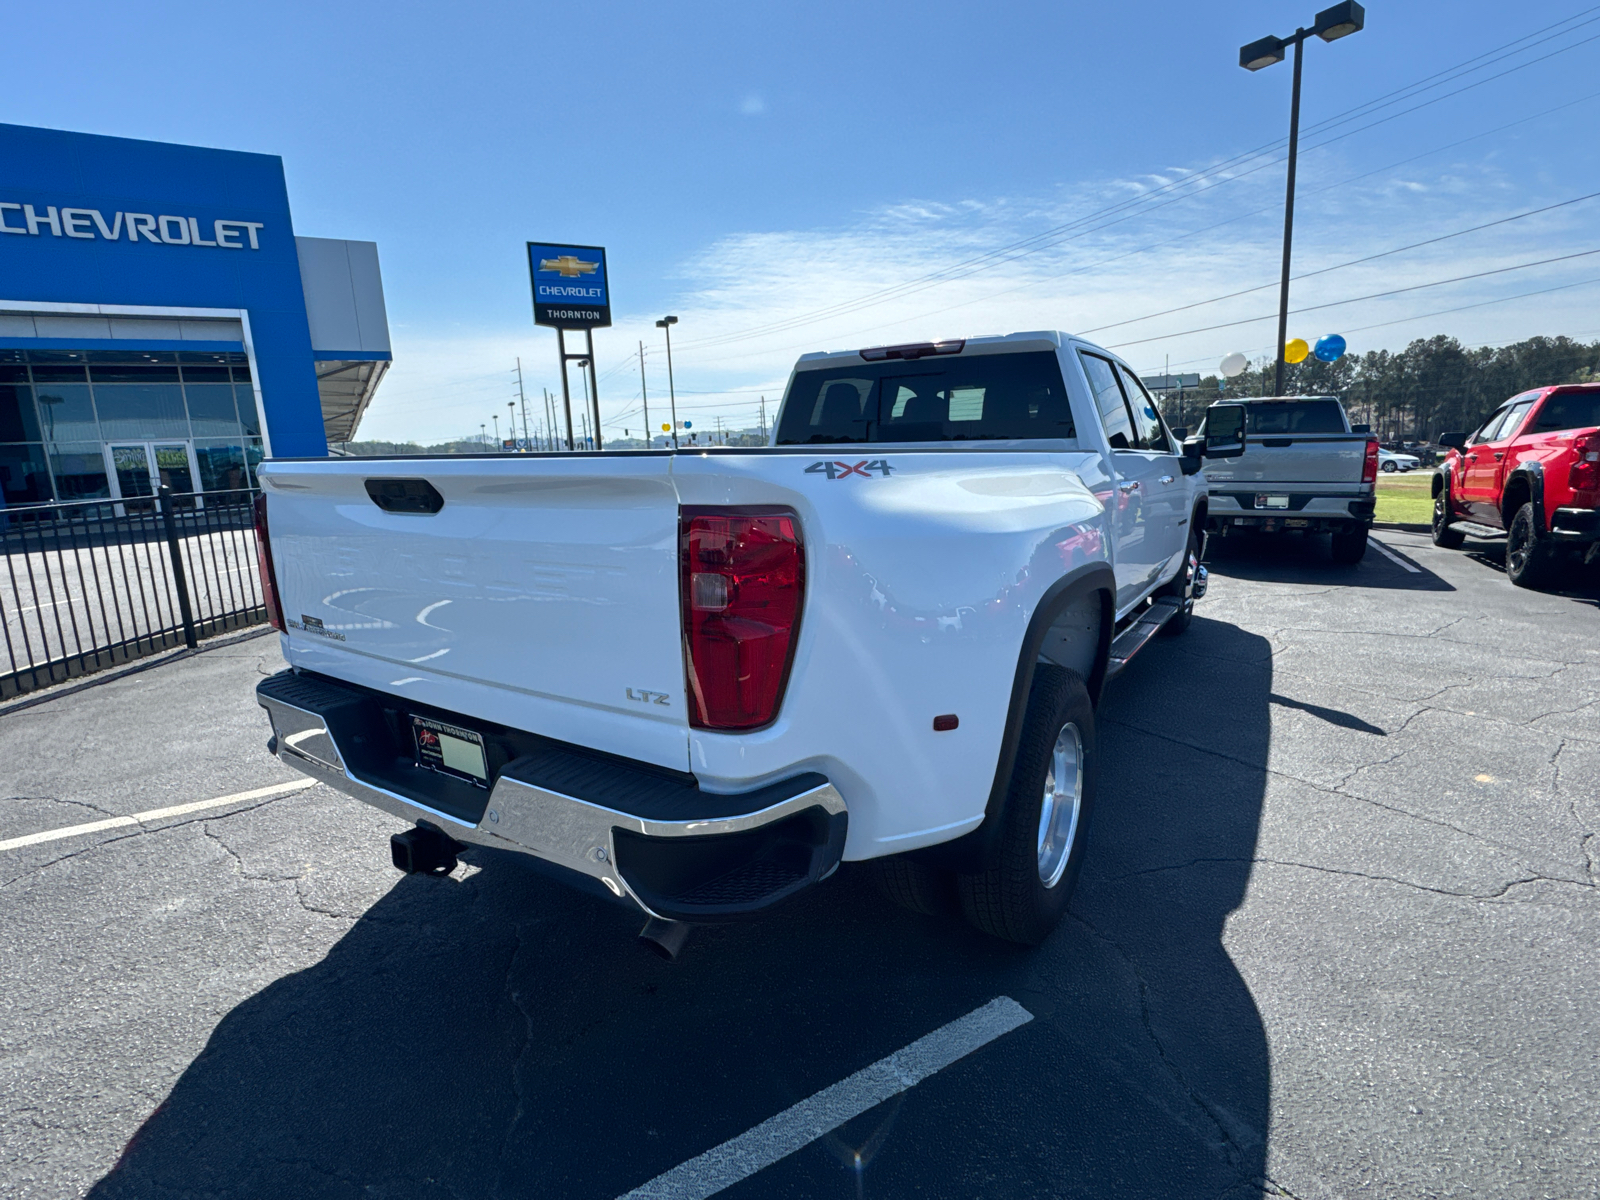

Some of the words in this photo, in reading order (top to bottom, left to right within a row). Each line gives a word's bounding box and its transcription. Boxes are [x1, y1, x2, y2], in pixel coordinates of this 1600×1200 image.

[0, 203, 264, 250] CHEVROLET
[539, 285, 602, 298] CHEVROLET
[546, 309, 600, 320] THORNTON
[625, 687, 671, 706] LTZ
[424, 720, 443, 732] JOHN
[442, 725, 479, 742] THORNTON
